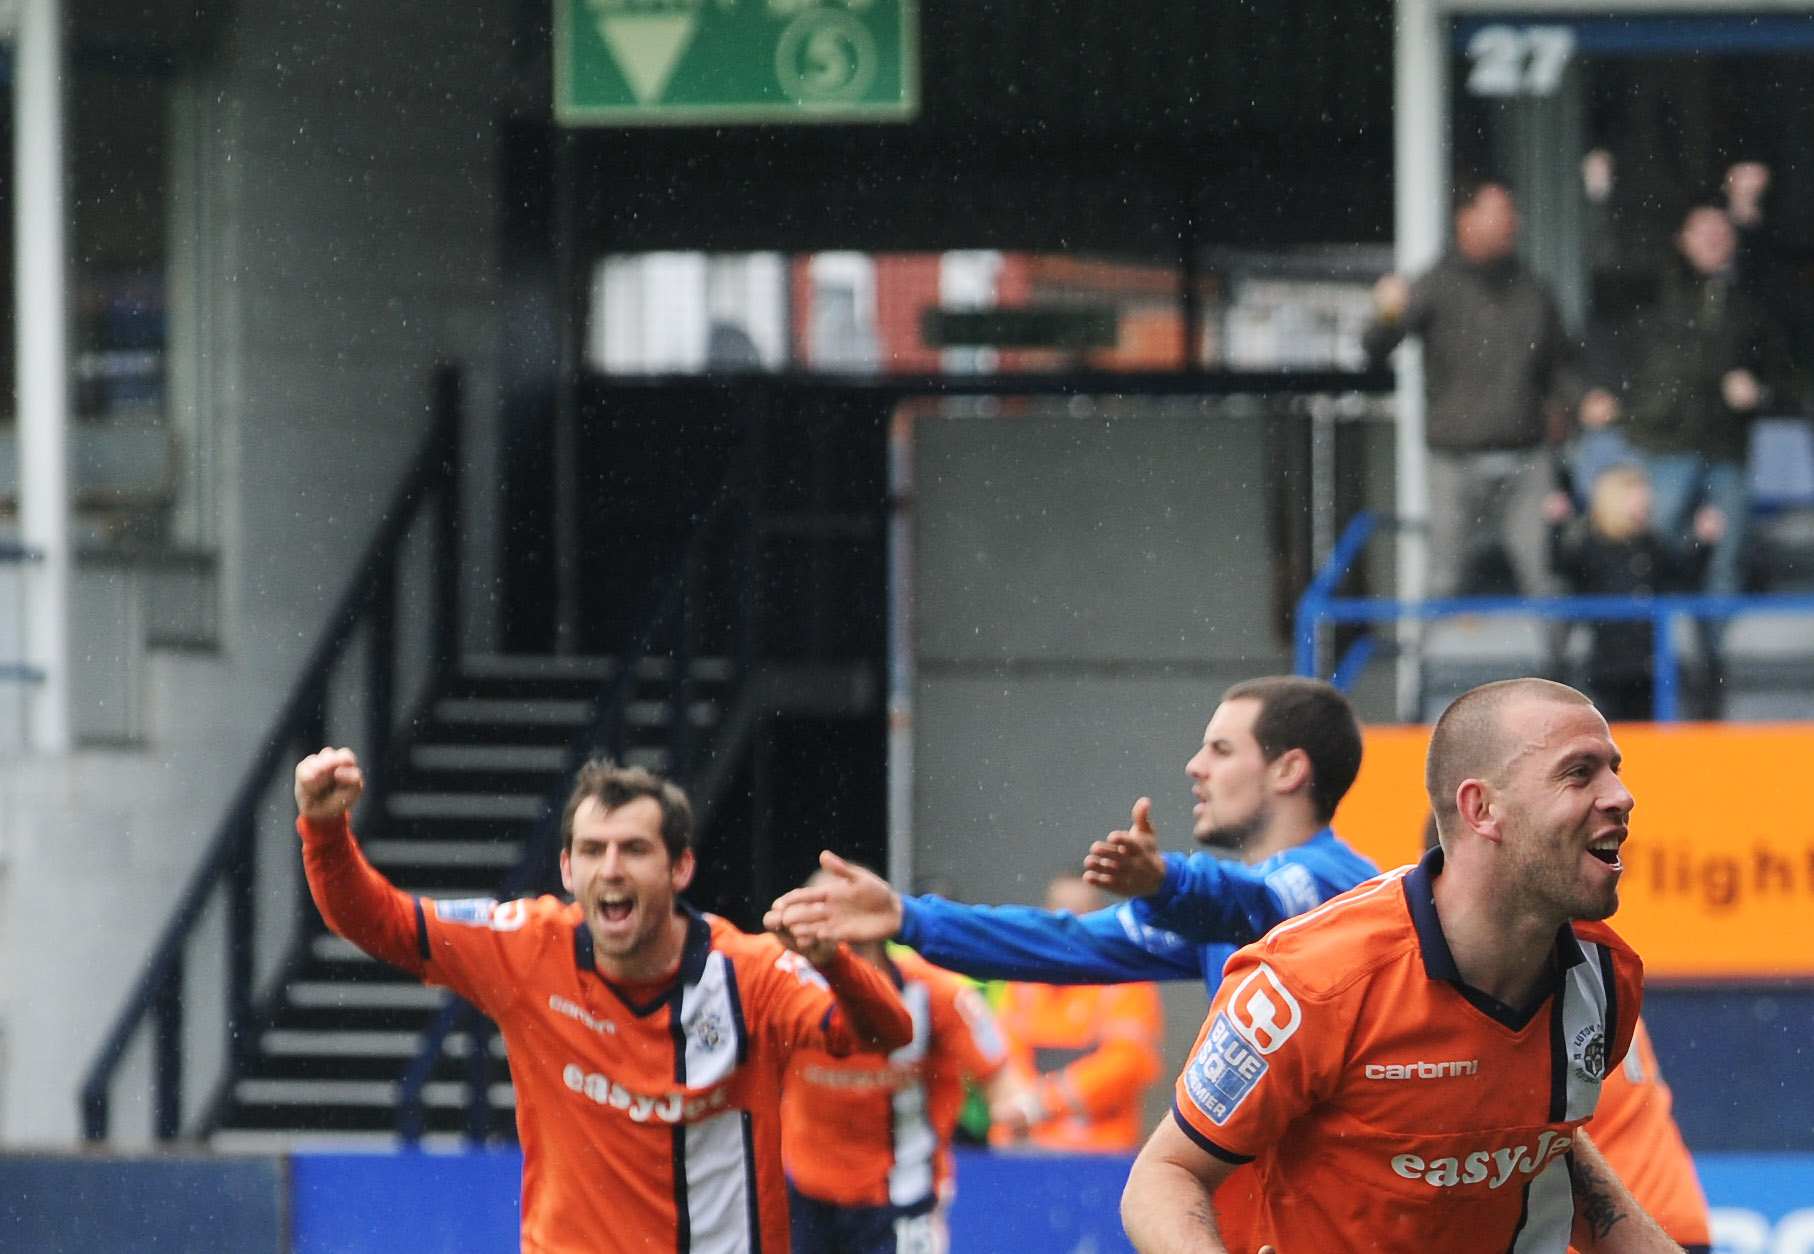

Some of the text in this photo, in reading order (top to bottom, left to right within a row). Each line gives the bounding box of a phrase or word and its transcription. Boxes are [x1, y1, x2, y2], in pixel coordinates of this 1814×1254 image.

[1466, 25, 1576, 97] 27
[1198, 1039, 1226, 1084] SQ
[1212, 1019, 1262, 1080] BLUE
[1365, 1060, 1479, 1080] carbrini
[1390, 1130, 1573, 1189] easyJe
